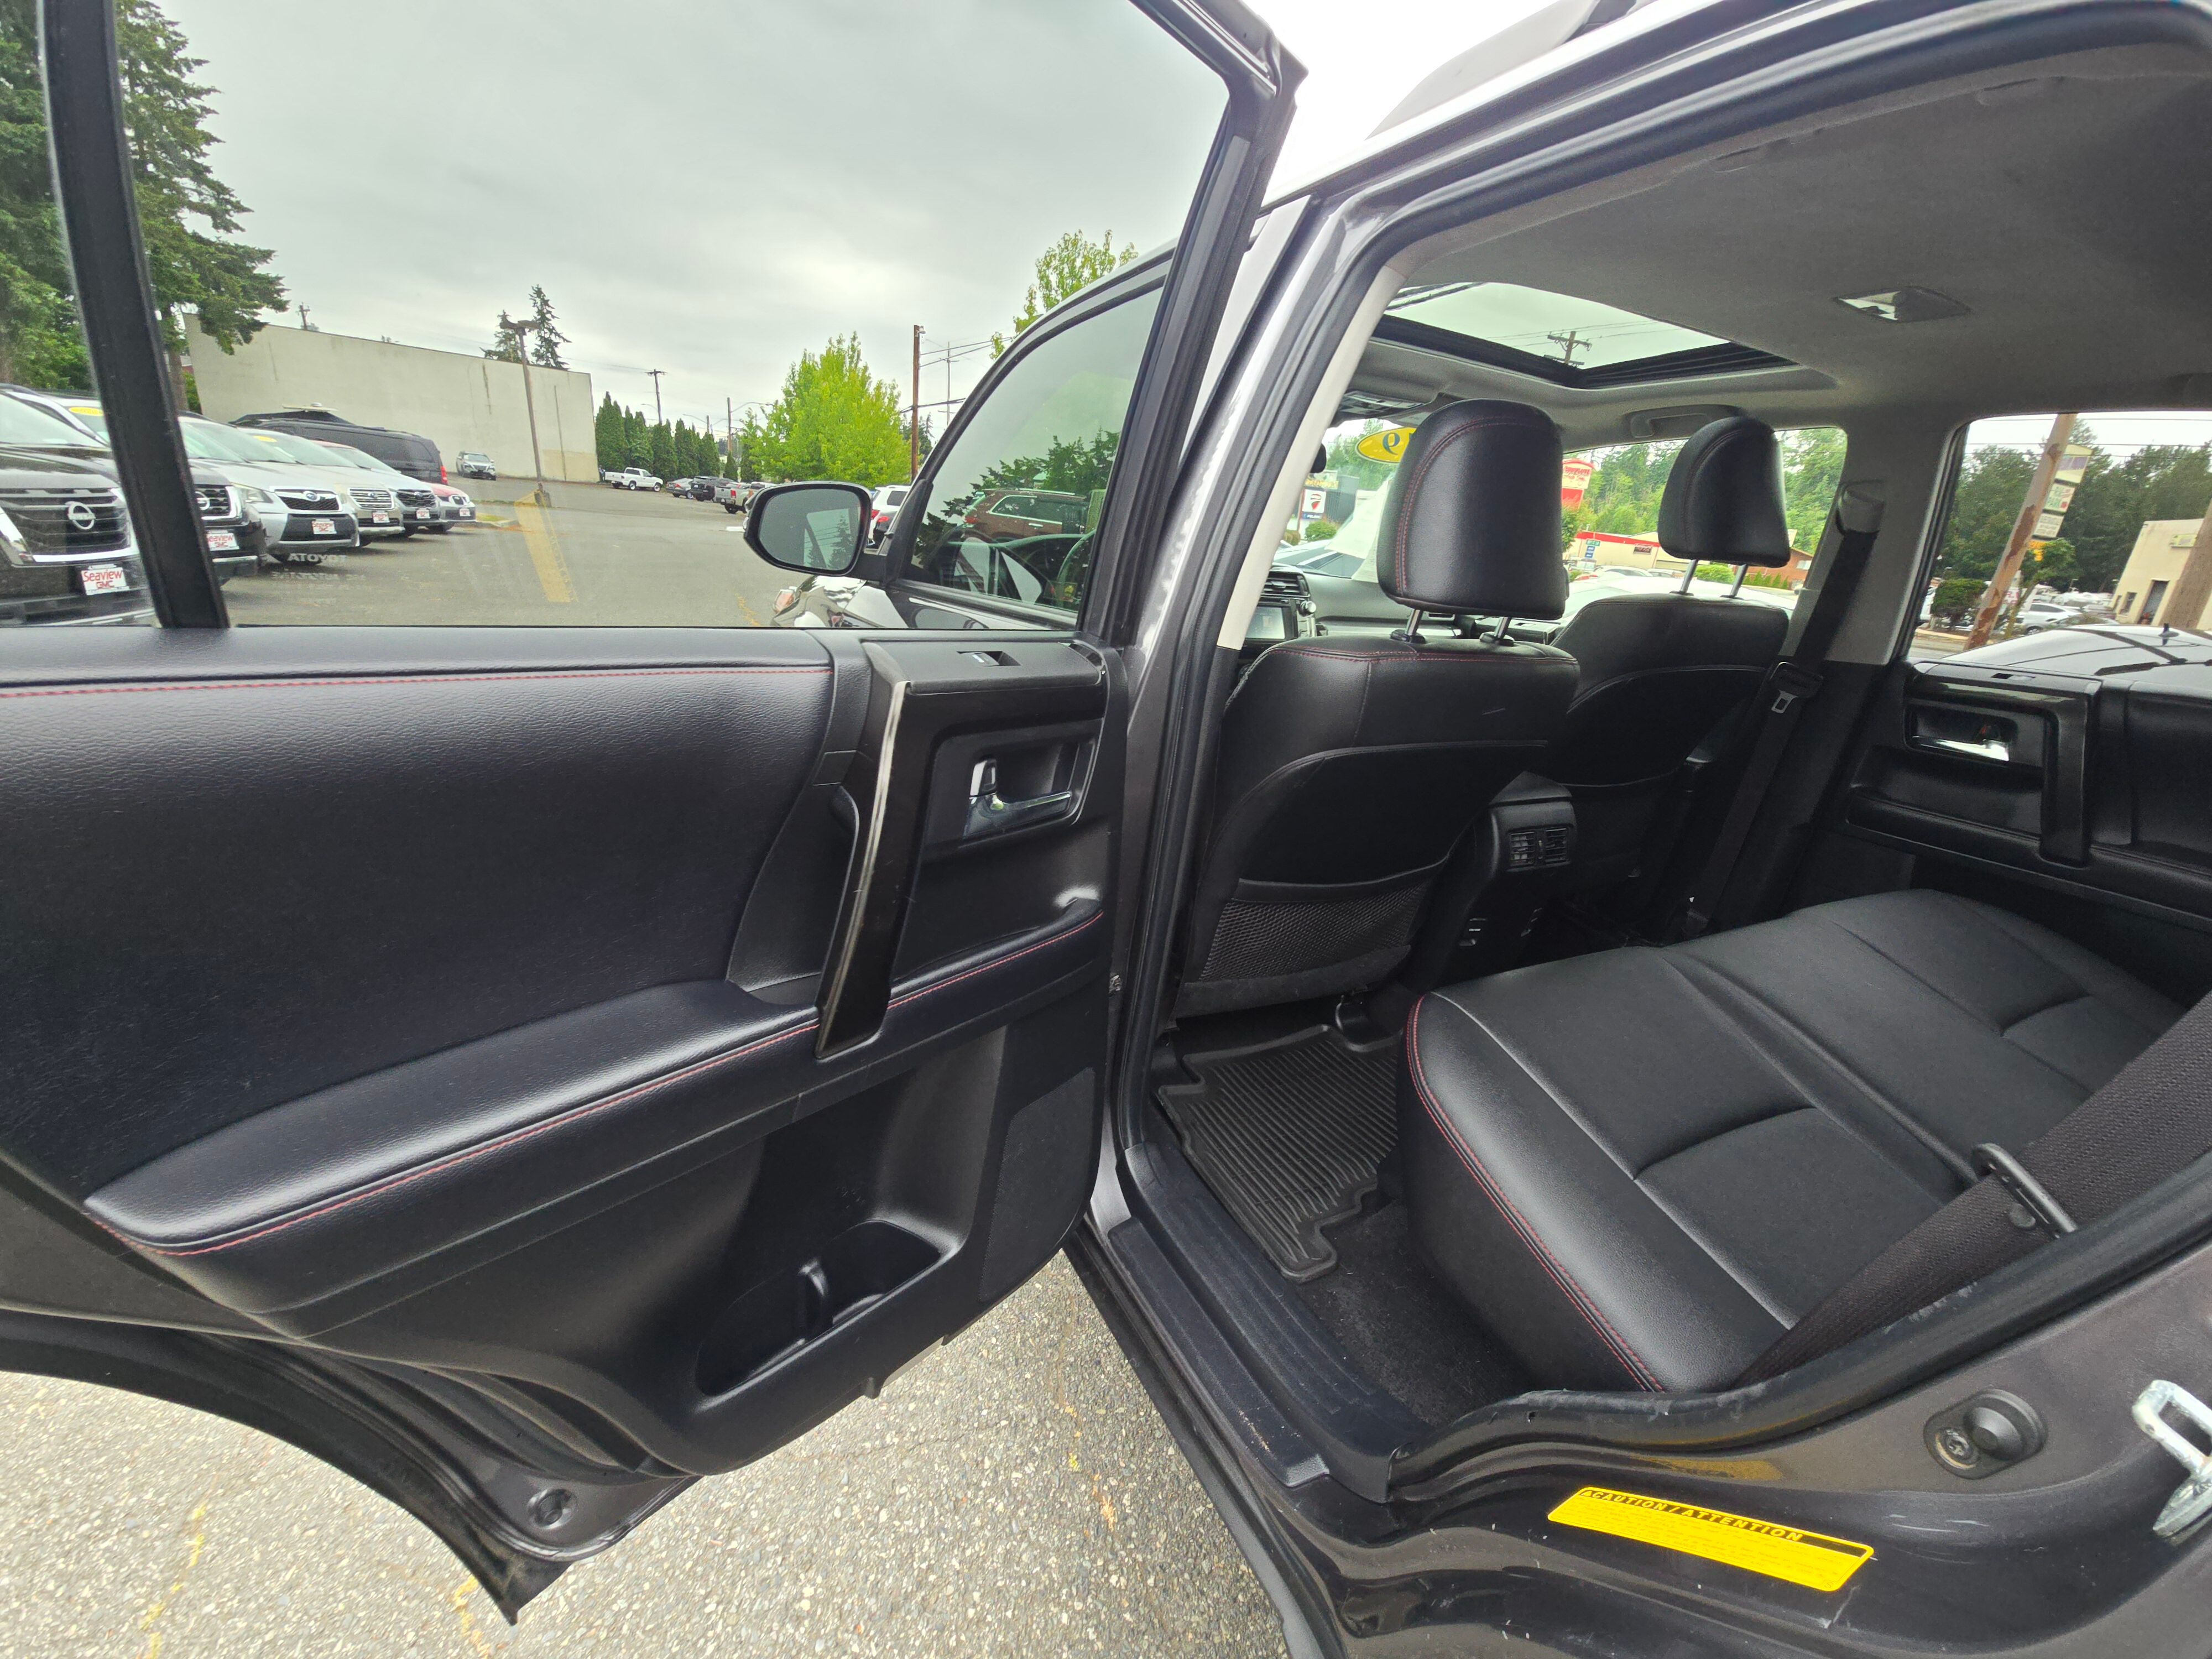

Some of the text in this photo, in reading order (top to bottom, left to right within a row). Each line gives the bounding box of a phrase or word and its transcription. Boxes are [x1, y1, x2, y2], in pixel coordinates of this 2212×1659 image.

[84, 570, 122, 582] Seaview
[96, 580, 114, 589] GMC
[1592, 1491, 1667, 1511] CAUTION
[1681, 1509, 1803, 1541] ATTENTION
